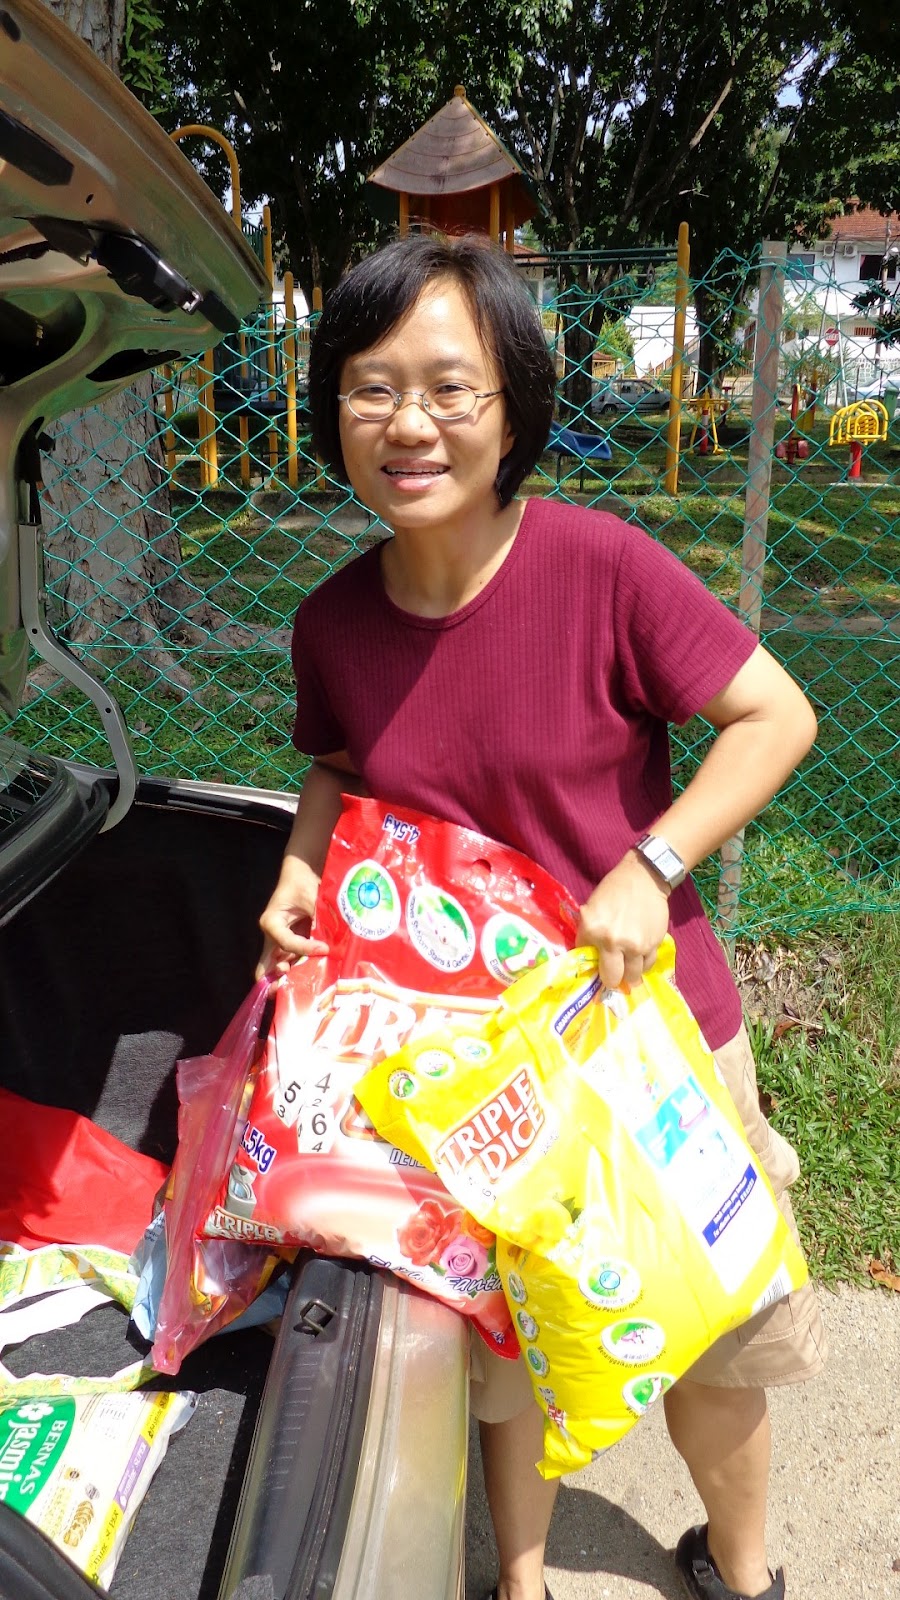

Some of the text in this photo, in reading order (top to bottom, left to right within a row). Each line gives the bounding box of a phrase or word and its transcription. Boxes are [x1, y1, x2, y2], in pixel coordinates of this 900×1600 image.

[383, 813, 420, 843] 4.5kg
[284, 1080, 302, 1104] 5
[314, 1072, 332, 1095] 4
[277, 1104, 287, 1119] 3
[311, 1112, 328, 1136] 6
[437, 1070, 536, 1178] TRIPLE
[311, 1141, 324, 1153] 4
[478, 1096, 545, 1181] DICE
[213, 1210, 281, 1241] TRIPLE
[444, 1274, 504, 1291] Fant
[0, 1419, 42, 1500] Jasmin
[20, 1420, 69, 1495] BERNAS
